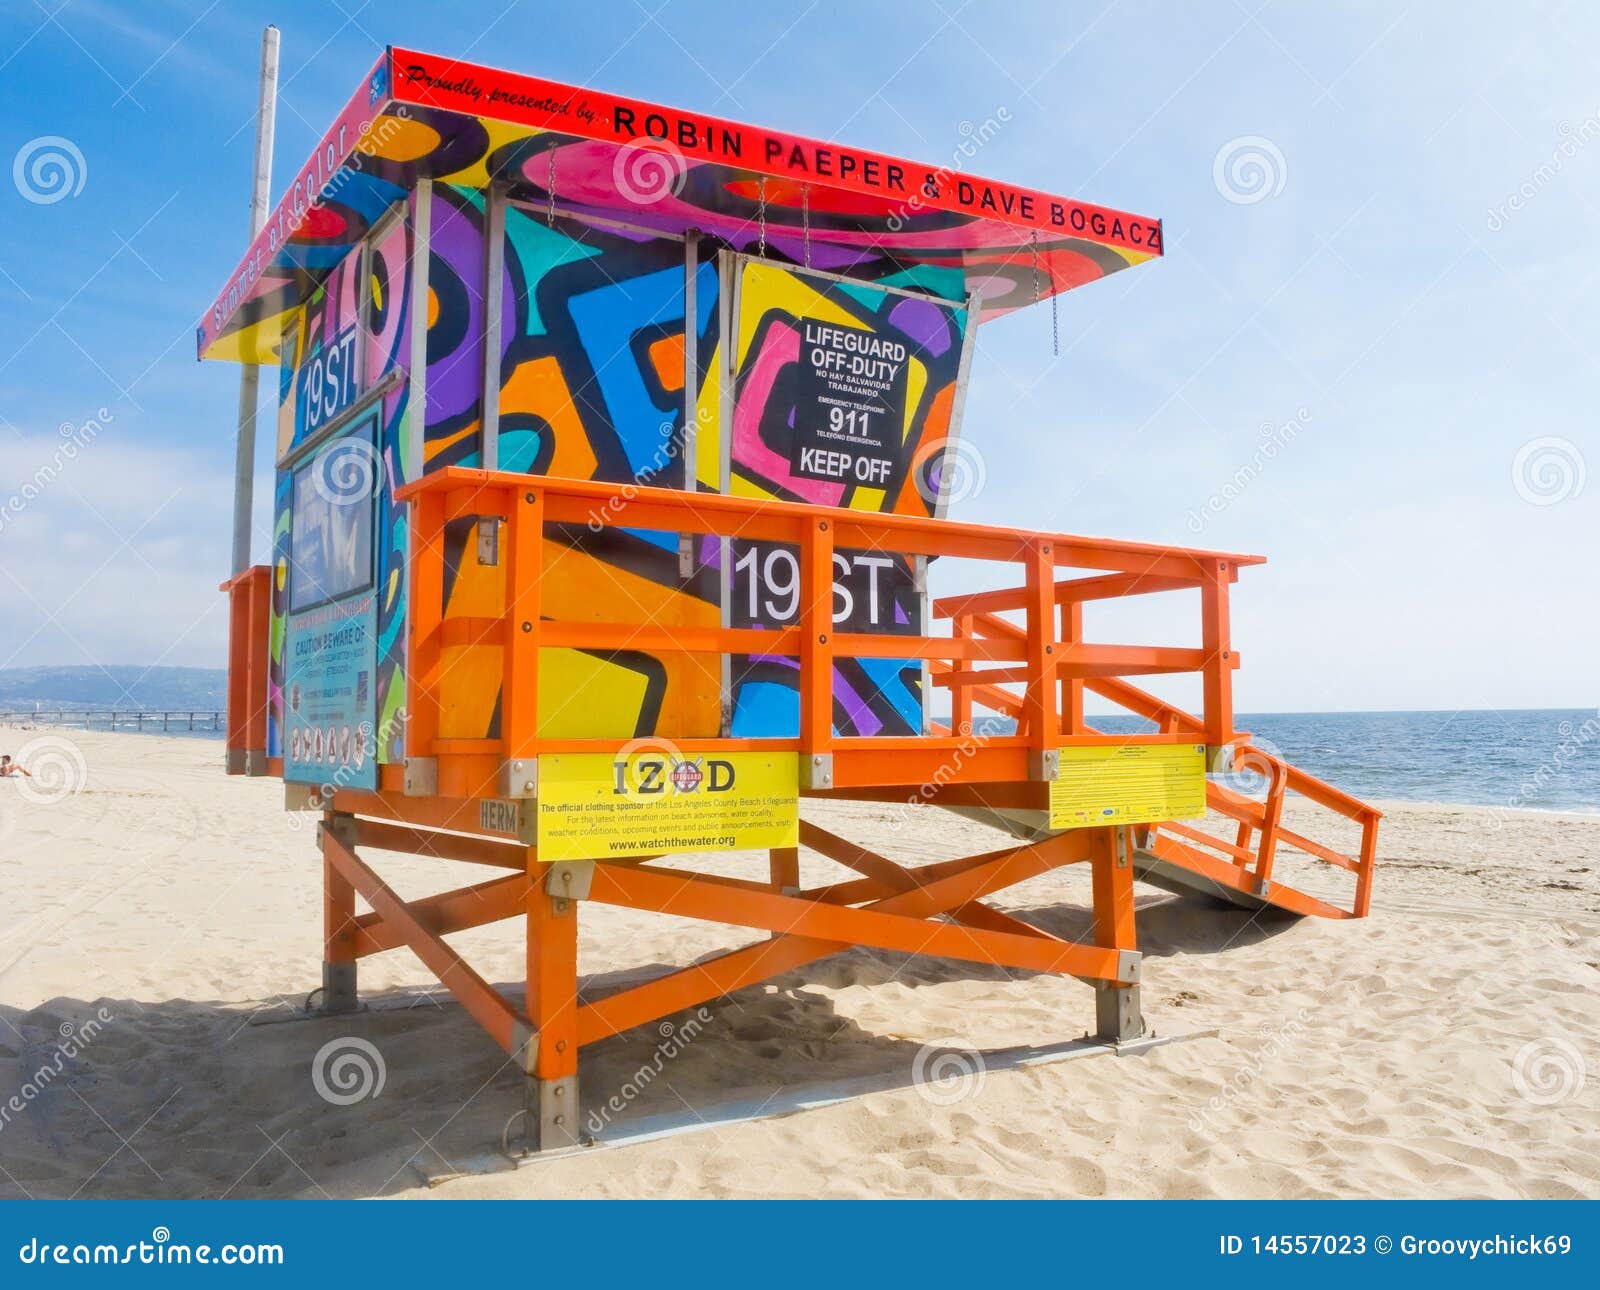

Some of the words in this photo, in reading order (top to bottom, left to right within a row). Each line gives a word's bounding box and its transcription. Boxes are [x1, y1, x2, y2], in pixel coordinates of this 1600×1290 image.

[406, 65, 481, 103] Proudly
[487, 88, 570, 116] presented
[614, 106, 742, 158] ROBIN
[765, 138, 905, 191] PAEPER
[924, 173, 940, 198] &
[958, 181, 1035, 220] DAVE
[1051, 203, 1160, 248] BOGACZ
[214, 247, 262, 331] Summer
[269, 205, 285, 252] of
[293, 123, 346, 216] Color
[806, 324, 906, 362] LIFEGUARD
[811, 348, 898, 382] OFF-DUTY
[816, 369, 827, 378] NO
[829, 373, 844, 382] HAY
[846, 375, 891, 391] SALVAVIDAS
[828, 381, 878, 398] TRABAJANDO
[818, 396, 851, 408] EMERGENCY
[853, 402, 885, 414] TELEPHONE
[829, 407, 869, 436] 911
[846, 435, 881, 447] EMERGENCIA
[800, 447, 852, 477] KEEP
[855, 456, 892, 484] OFF
[355, 625, 365, 643] OF
[542, 804, 555, 812] The
[557, 803, 583, 812] official
[586, 802, 614, 812] clothing
[617, 803, 644, 812] sponsor
[655, 801, 668, 809] the
[670, 801, 682, 809] Los
[685, 800, 712, 809] Angeles
[714, 799, 737, 808] County
[740, 798, 760, 806] Beach
[567, 815, 578, 824] For
[581, 815, 593, 823] the
[595, 815, 616, 823] latest
[618, 813, 659, 822] information
[672, 812, 692, 820] beach
[731, 810, 748, 818] water
[548, 828, 577, 837] weather
[622, 825, 657, 835] upcoming
[660, 824, 681, 832] events
[683, 823, 697, 831] and
[699, 822, 719, 832] public
[609, 835, 736, 851] www.watchthewater.org
